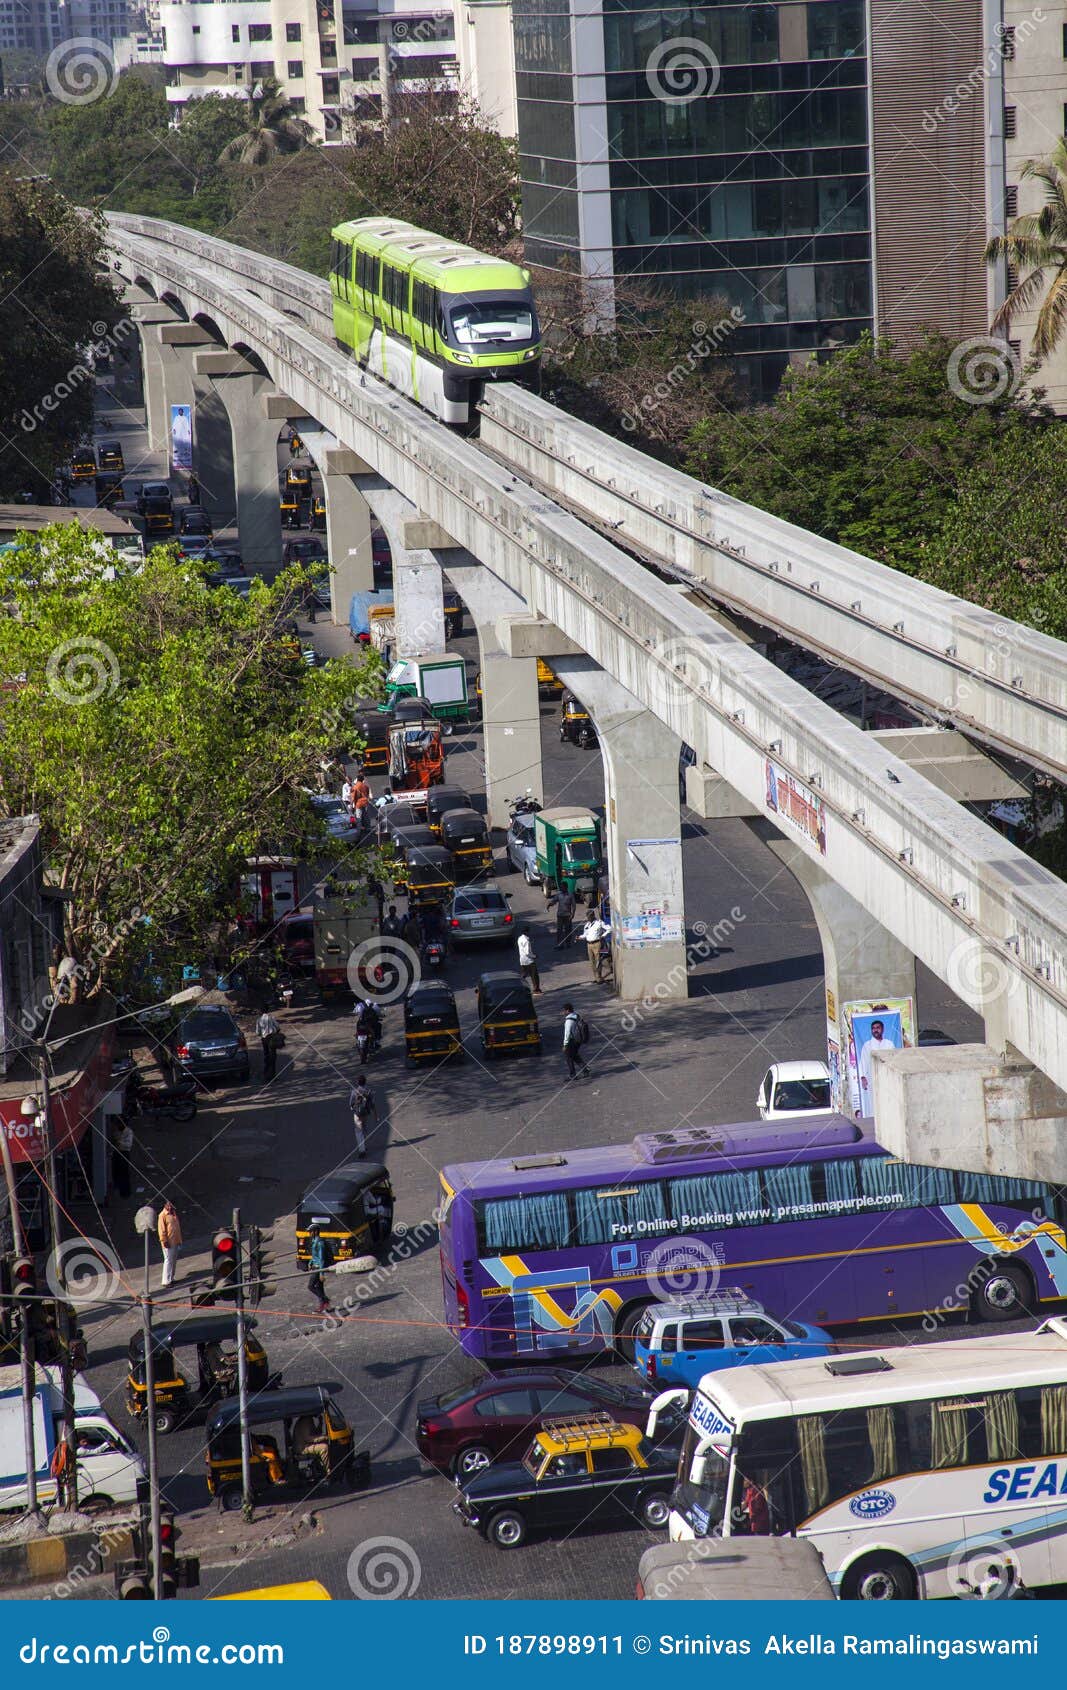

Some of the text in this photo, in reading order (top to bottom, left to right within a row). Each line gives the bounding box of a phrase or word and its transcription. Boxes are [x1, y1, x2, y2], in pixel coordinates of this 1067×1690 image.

[611, 1222, 633, 1236] For
[636, 1217, 678, 1233] Online
[681, 1213, 733, 1228] Booking
[776, 1192, 904, 1219] prasannapurple.com
[640, 1242, 726, 1267] PURPLE
[983, 1463, 1067, 1504] SEA
[860, 1499, 886, 1511] STC
